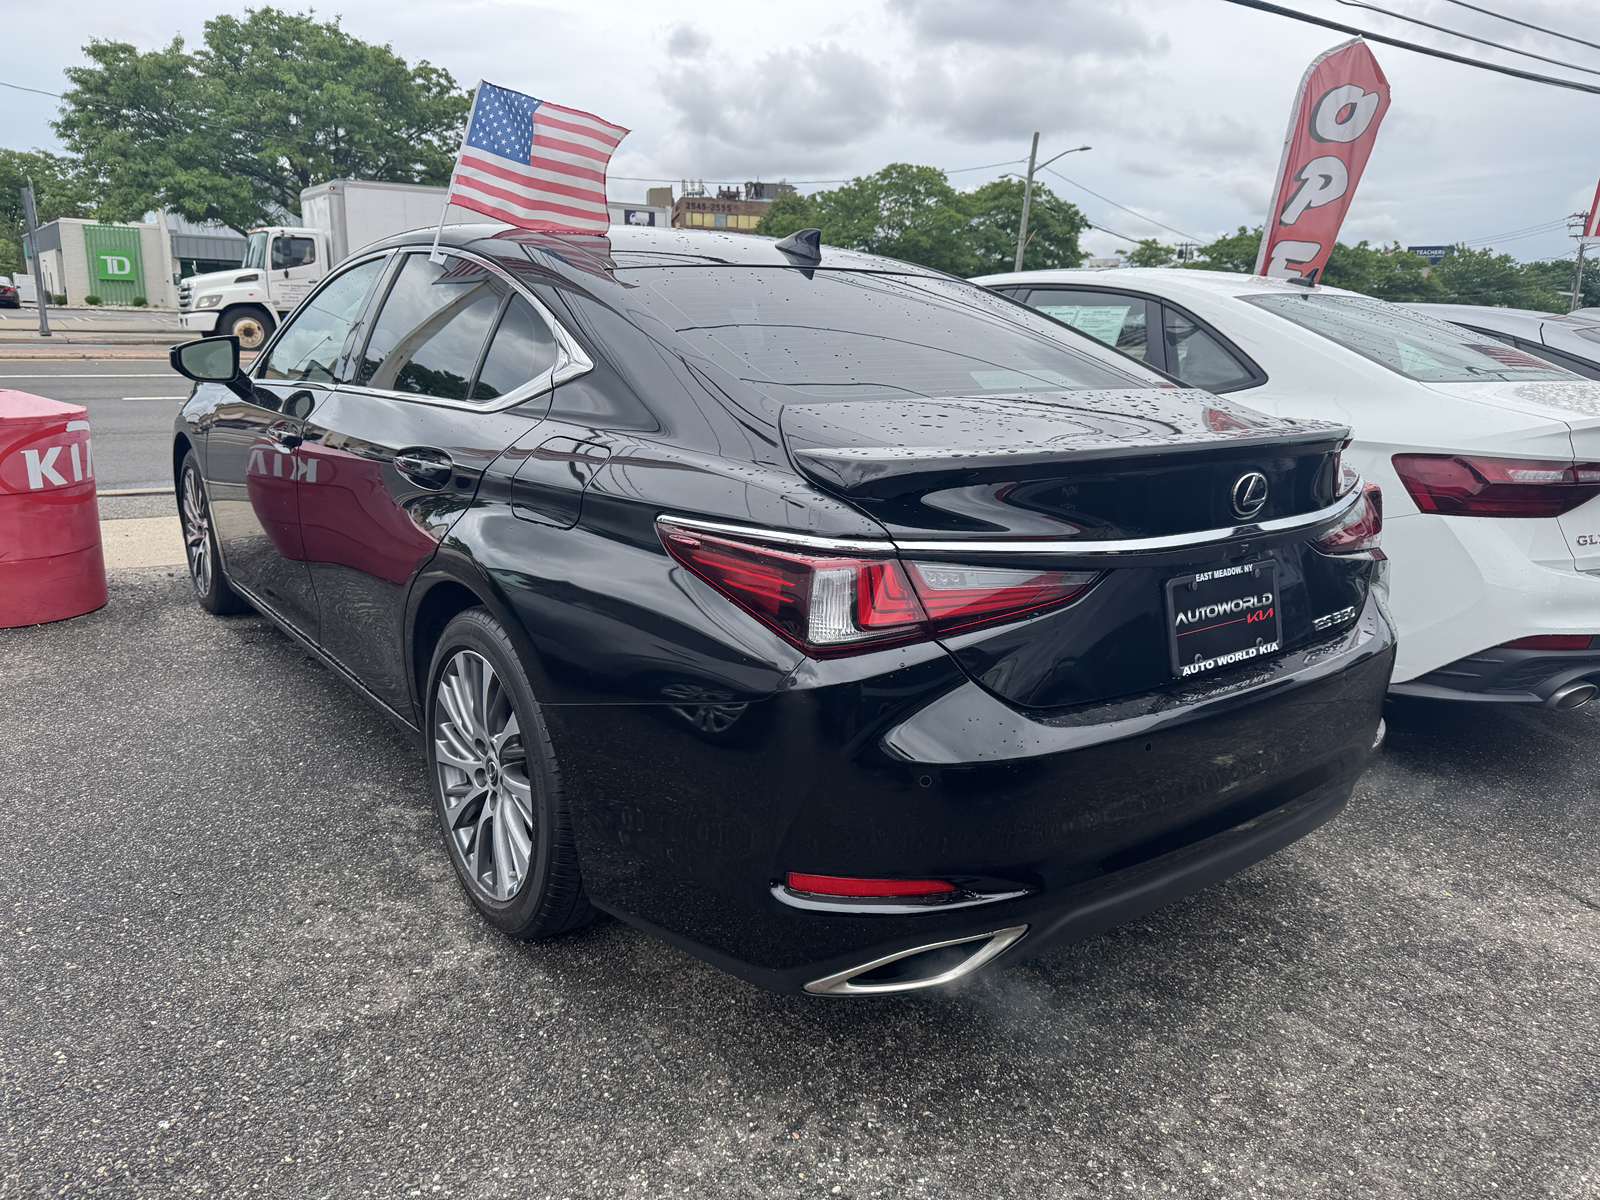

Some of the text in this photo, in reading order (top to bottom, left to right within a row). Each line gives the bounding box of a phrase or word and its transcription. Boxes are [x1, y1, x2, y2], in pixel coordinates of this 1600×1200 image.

[100, 255, 131, 275] TD
[1576, 534, 1600, 546] GL
[1195, 571, 1213, 582] EAST
[1244, 563, 1254, 572] NY
[1175, 592, 1273, 627] AUTOWORLD
[1247, 607, 1274, 624] KIA
[1182, 642, 1279, 676] AUTO WORLD KIA
